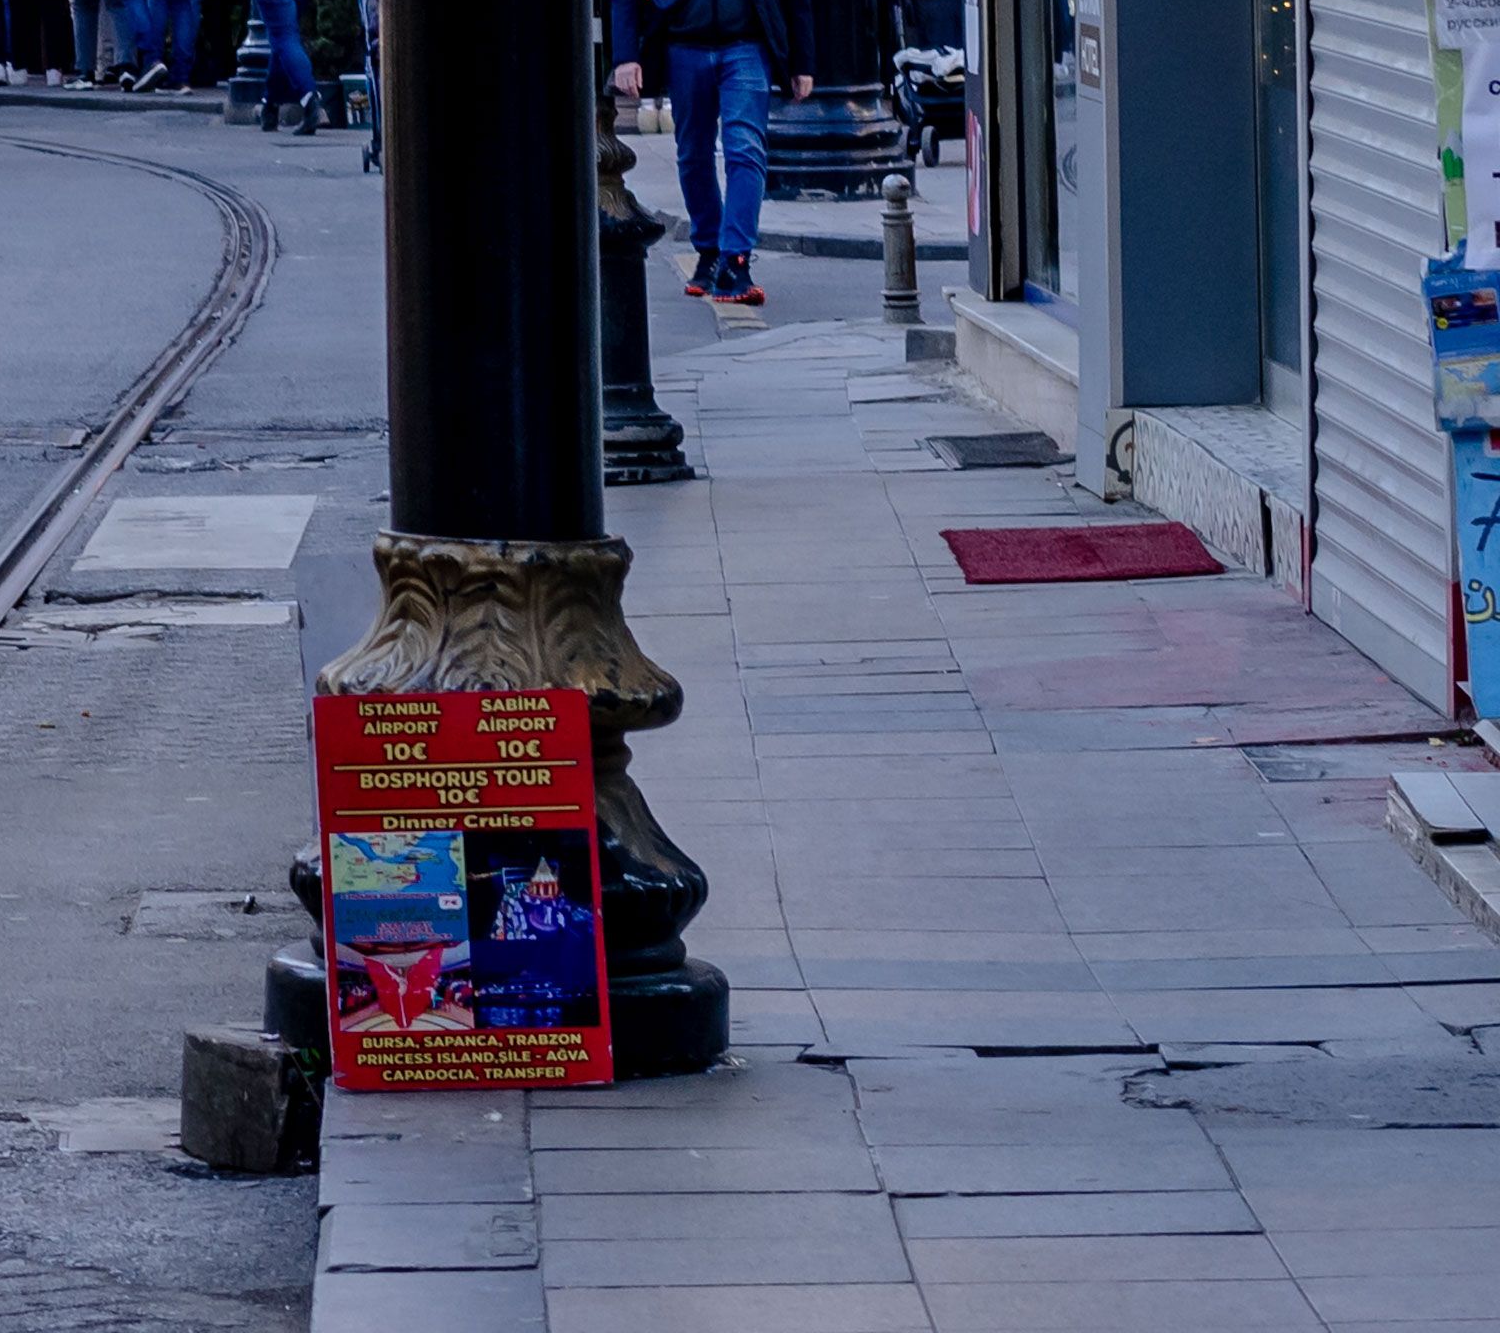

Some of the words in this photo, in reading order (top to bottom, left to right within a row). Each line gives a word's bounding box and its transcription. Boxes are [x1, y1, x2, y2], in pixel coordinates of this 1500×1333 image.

[359, 701, 442, 717] İSTANBUL
[481, 696, 550, 713] SABİHA
[363, 718, 439, 735] AİRPORT
[476, 714, 557, 733] AİRPORT
[383, 742, 428, 762] 10€
[497, 739, 542, 759] 10€
[359, 770, 489, 790] BOSPHORUS
[493, 769, 551, 785] TOUR
[437, 789, 481, 805] 10€
[382, 815, 458, 830] Dinner
[463, 814, 535, 829] Cruise
[362, 1036, 420, 1051] BURSA,
[424, 1034, 503, 1049] SAPANCA,
[506, 1032, 582, 1047] TRABZON
[357, 1052, 434, 1066] PRINCESS
[545, 1047, 589, 1062] AĞVA
[382, 1068, 480, 1082] CAPADOCIA,
[483, 1066, 566, 1081] TRANSFER
